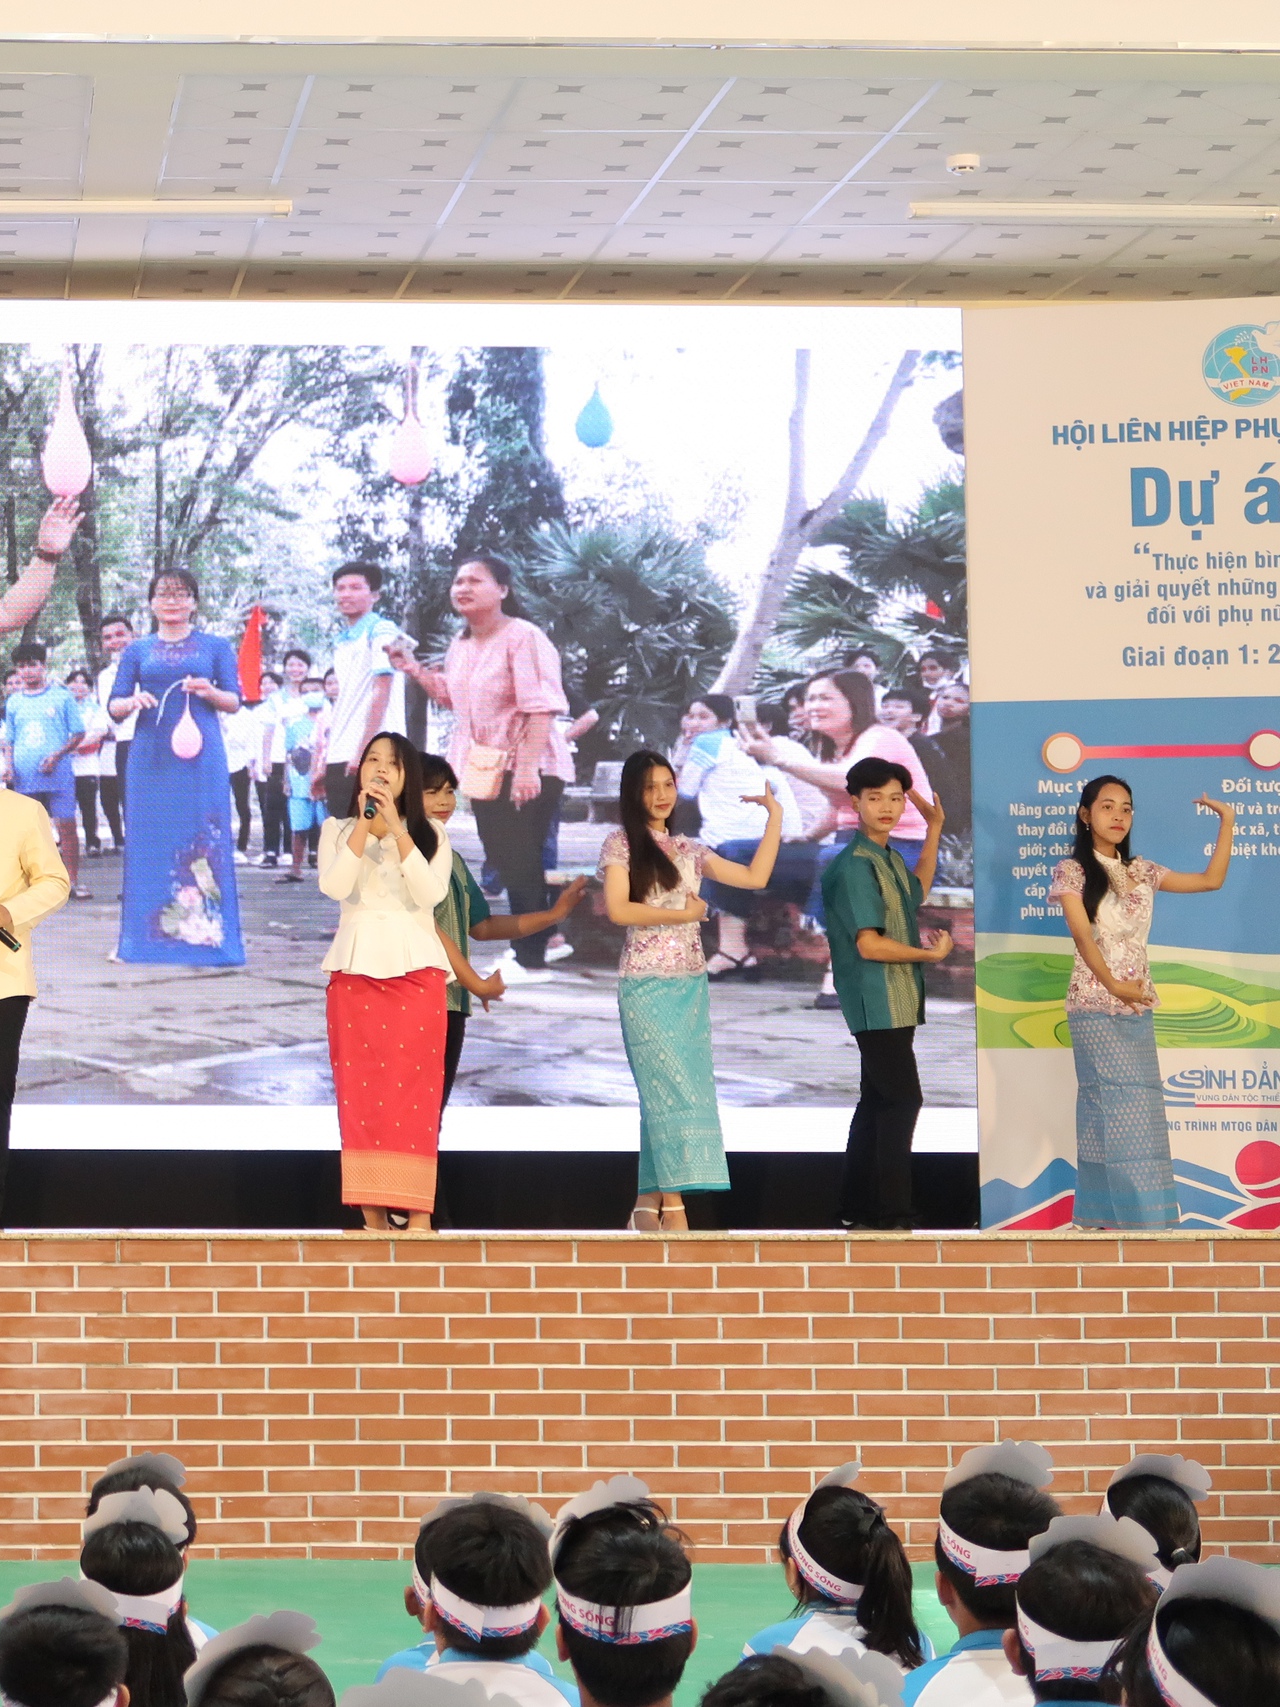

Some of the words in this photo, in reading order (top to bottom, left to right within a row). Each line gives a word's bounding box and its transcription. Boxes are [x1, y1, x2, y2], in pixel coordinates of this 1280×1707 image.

[1252, 356, 1268, 364] LH
[1252, 366, 1269, 374] PN
[1248, 380, 1270, 388] NAM
[1052, 420, 1095, 451] HỘI
[1102, 418, 1162, 444] LIÊN
[1168, 415, 1228, 446] HIỆP
[1130, 466, 1220, 540] Dự
[1206, 551, 1248, 573] hiện
[1085, 581, 1108, 599] và
[1114, 578, 1150, 602] giải
[1157, 576, 1211, 601] quyết
[1218, 578, 1278, 599] những
[1147, 604, 1176, 624] đối
[1182, 605, 1211, 624] với
[1218, 604, 1254, 626] phụ
[1122, 646, 1166, 667] Giai
[1174, 645, 1229, 670] đoạn
[1238, 644, 1259, 665] 1:
[1038, 780, 1074, 797] Mục
[1222, 776, 1252, 794] Đối
[1009, 803, 1042, 819] Nâng
[1044, 804, 1066, 816] cao
[1248, 802, 1263, 815] và
[1017, 823, 1046, 839] thay
[1048, 820, 1068, 836] đổi
[1249, 822, 1270, 838] xã,
[1019, 843, 1047, 860] giới;
[1231, 842, 1258, 860] biệt
[1012, 862, 1048, 879] quyết
[1024, 882, 1046, 900] cấp
[1020, 904, 1044, 920] phụ
[1180, 1064, 1236, 1090] BÌNH
[1185, 1118, 1218, 1132] TRÌNH
[1222, 1121, 1252, 1132] MTQG
[1256, 1118, 1278, 1132] DÂN
